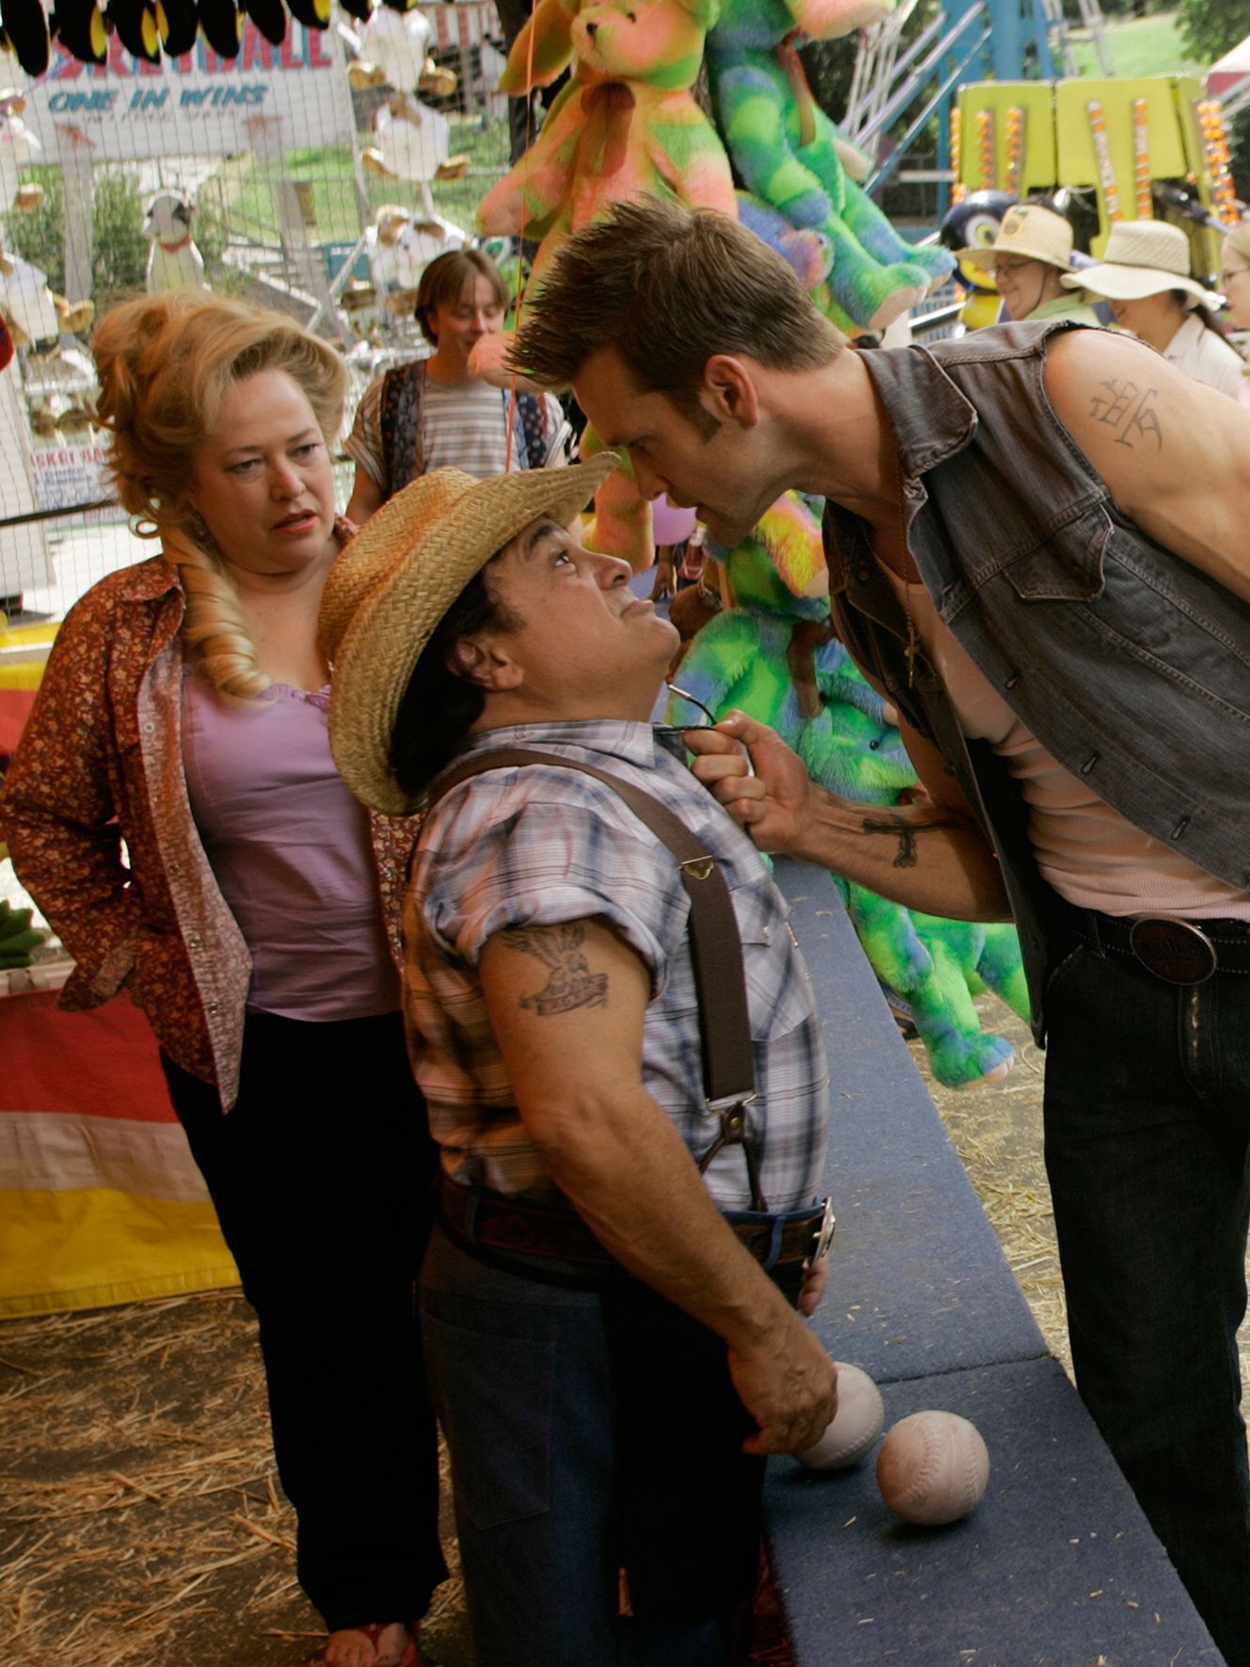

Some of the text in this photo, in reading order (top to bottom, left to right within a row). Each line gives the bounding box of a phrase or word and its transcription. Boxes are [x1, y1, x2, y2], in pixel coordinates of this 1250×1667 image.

[48, 84, 268, 112] ONE IN WINS
